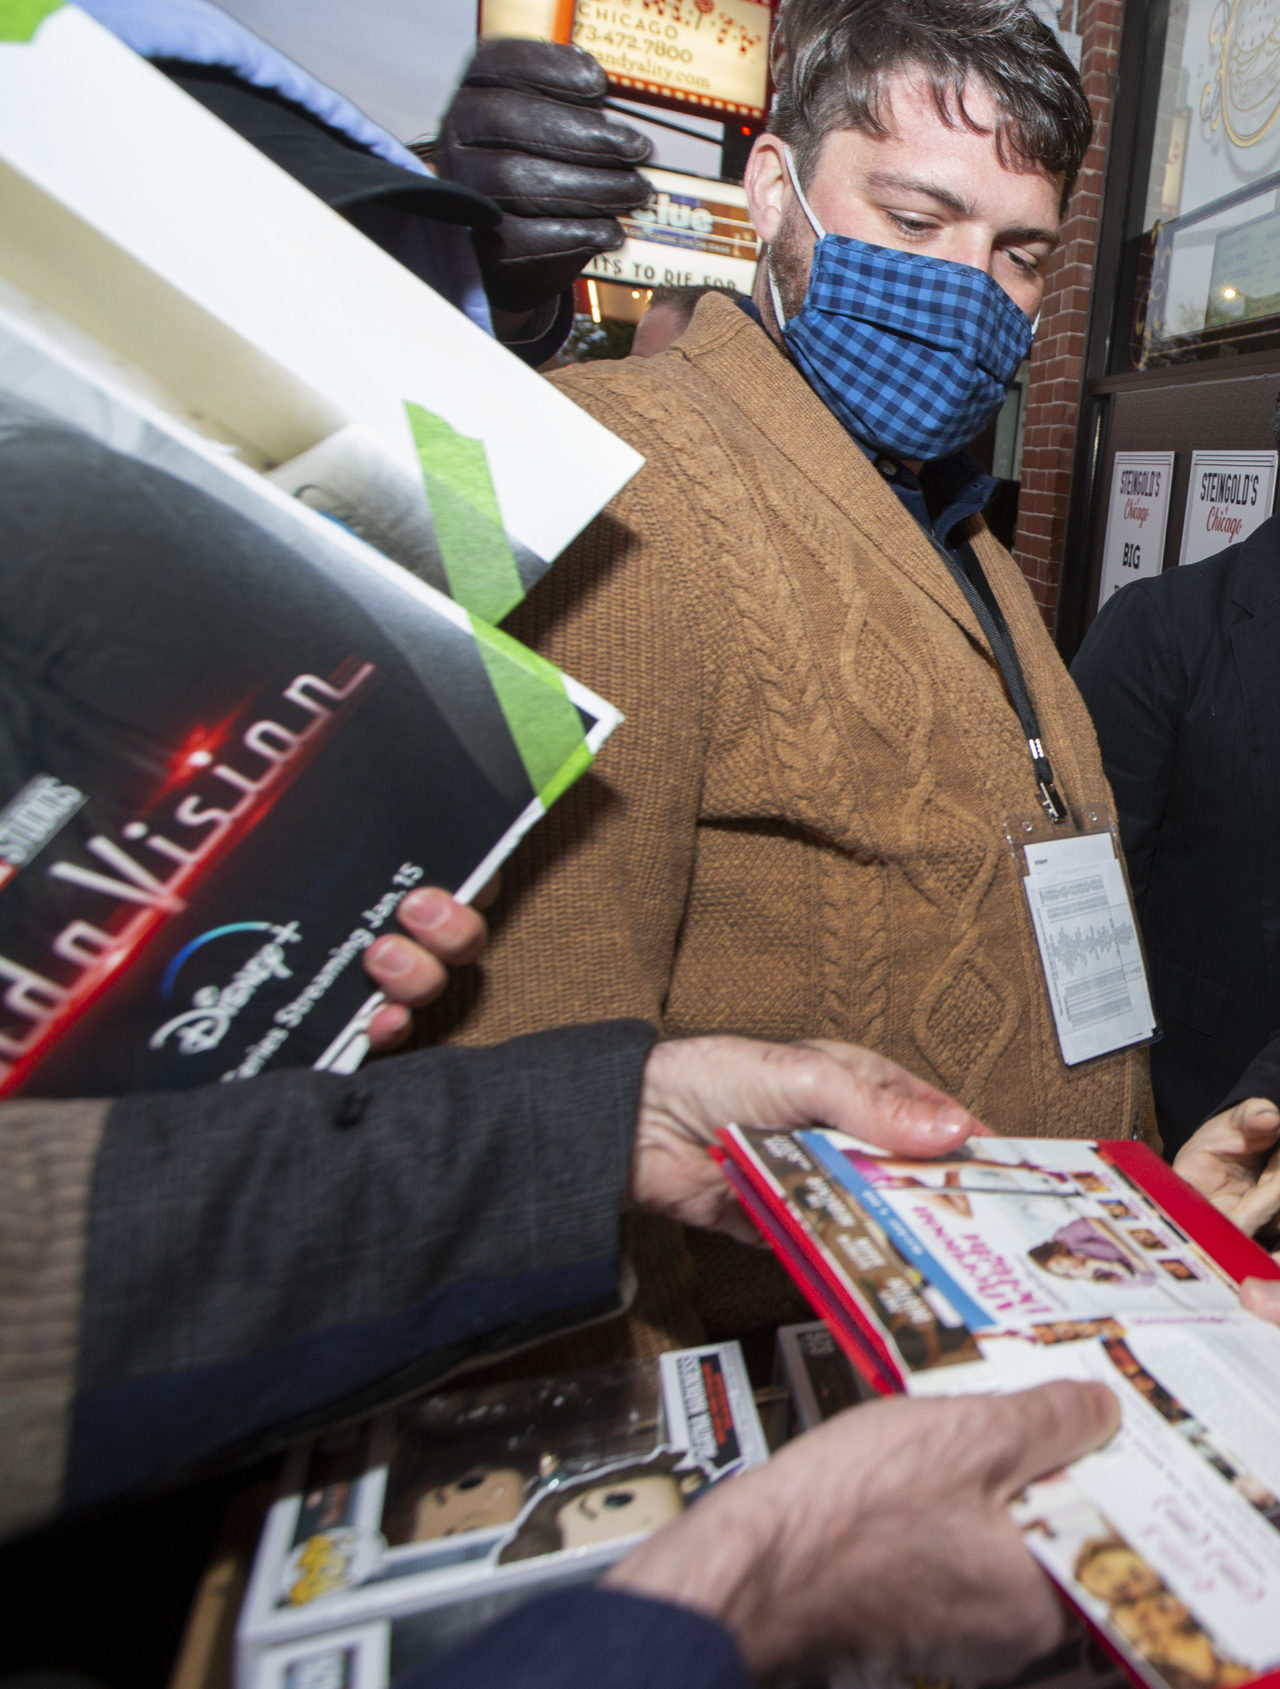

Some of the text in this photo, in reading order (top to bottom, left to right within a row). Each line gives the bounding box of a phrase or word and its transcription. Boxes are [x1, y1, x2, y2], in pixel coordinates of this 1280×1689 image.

[578, 3, 679, 40] CHICAGO
[632, 261, 656, 281] TO
[664, 269, 694, 287] DIE
[1120, 470, 1161, 497] STEINGOLD'S
[1200, 472, 1259, 506] STEINGOLD'S
[1124, 498, 1150, 528] Chicago
[1206, 506, 1243, 543] Chicago
[1122, 543, 1141, 569] BIG
[221, 1027, 290, 1084] eries
[274, 927, 376, 1029] Streaming
[392, 861, 423, 887] 15
